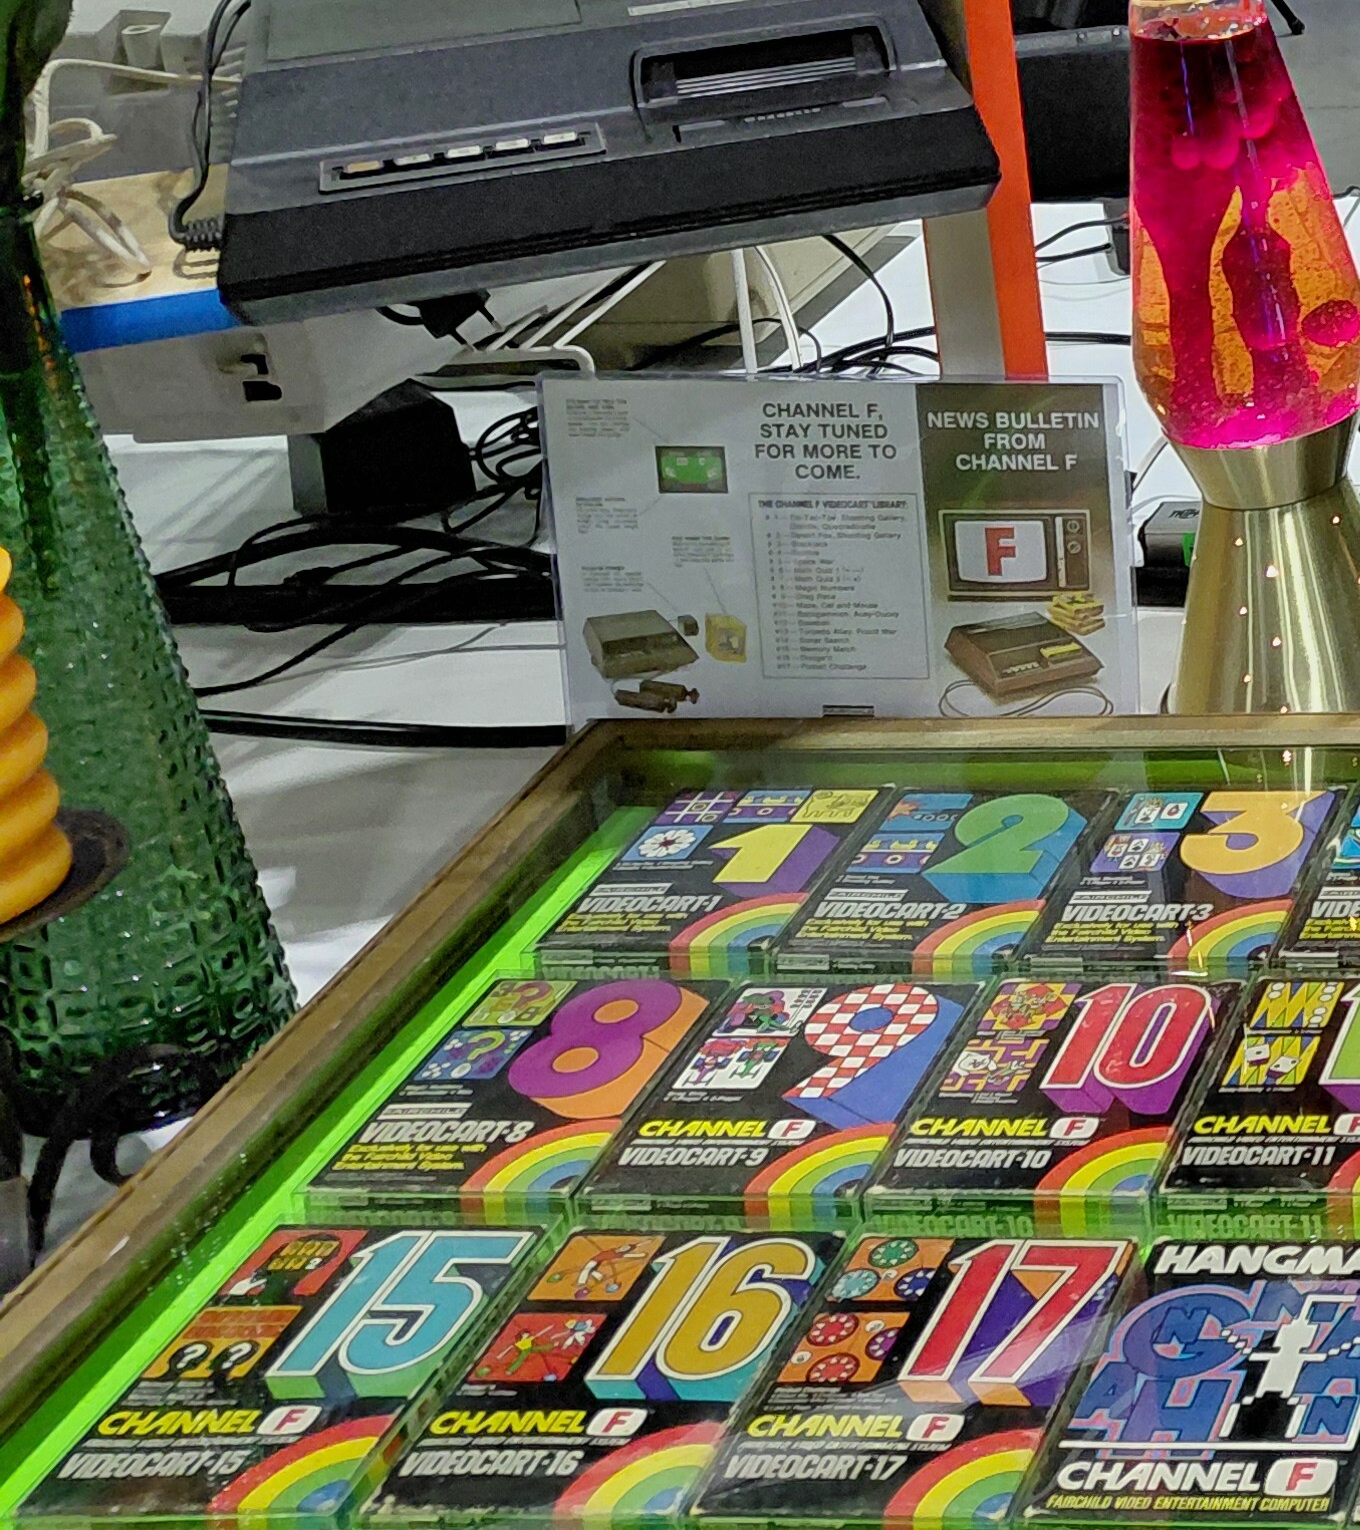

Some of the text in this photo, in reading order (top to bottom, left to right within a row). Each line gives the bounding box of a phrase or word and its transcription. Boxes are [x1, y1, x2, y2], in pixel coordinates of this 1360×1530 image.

[763, 403, 884, 421] CHANNEL F,
[927, 412, 1099, 429] NEWS BULLETIN
[760, 423, 888, 439] STAY TUNED
[984, 433, 1045, 450] FROM
[754, 444, 897, 460] FOR MORE TO
[955, 454, 1078, 470] CHANNEL F
[795, 464, 860, 481] COME.
[984, 526, 1017, 577] F
[921, 793, 1070, 874] 2
[1180, 790, 1328, 875] 3
[711, 823, 811, 884] 1
[577, 894, 723, 915] VIDEOCART-1
[814, 900, 968, 921] VIDEOCART-2
[1060, 903, 1214, 923] VIDEOCART-3
[508, 979, 682, 1100] 8
[783, 983, 938, 1101] 9
[1040, 981, 1213, 1091] 10
[357, 1120, 537, 1145] VIDEOCART-8
[616, 1146, 769, 1168] VIDEOCART-9
[893, 1147, 1053, 1170] VIDEOCART-10
[1181, 1144, 1335, 1168] VIDEOCART-11
[276, 1229, 534, 1380] 15
[594, 1235, 817, 1384] 16
[894, 1240, 1132, 1387] 17
[56, 1449, 252, 1480] VIDEOCART-15
[398, 1450, 584, 1479] VIDEOCART-16
[723, 1453, 908, 1482] VIDEOCART-17
